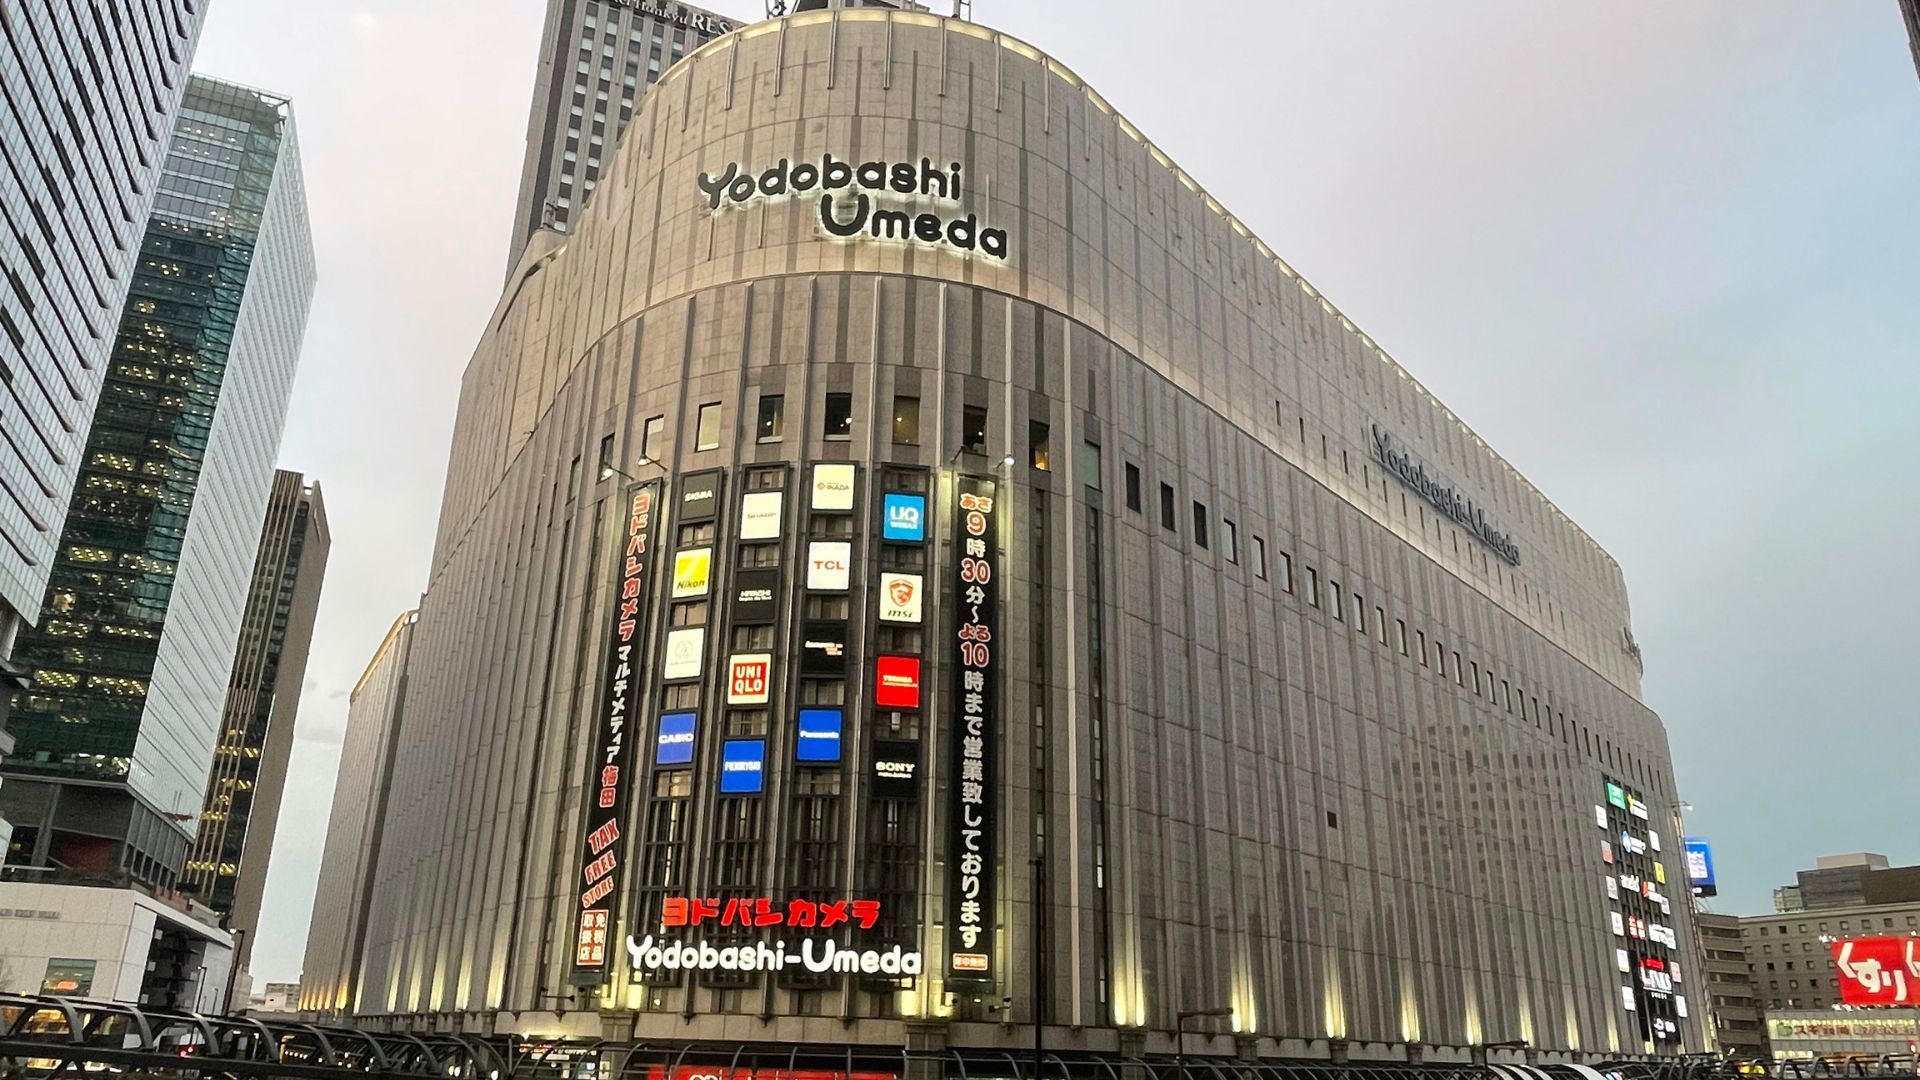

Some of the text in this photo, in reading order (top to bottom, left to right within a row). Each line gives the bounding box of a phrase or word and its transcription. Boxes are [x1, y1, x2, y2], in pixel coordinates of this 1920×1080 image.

[698, 153, 960, 209] Yodobashi
[821, 193, 1007, 260] Umeda
[890, 505, 919, 522] UQ
[814, 561, 844, 570] TCL
[677, 580, 705, 589] Nikon
[734, 679, 763, 694] QLO
[735, 665, 762, 679] UNI
[658, 733, 694, 744] CASIO
[875, 761, 915, 772] SONY
[588, 817, 620, 855] TAX
[584, 849, 616, 885] FREE
[582, 876, 614, 908] STORE
[662, 897, 880, 929] ヨドバシカメラ
[626, 935, 922, 975] Yodobashi-Umeda
[1837, 942, 1907, 1001] くすり
